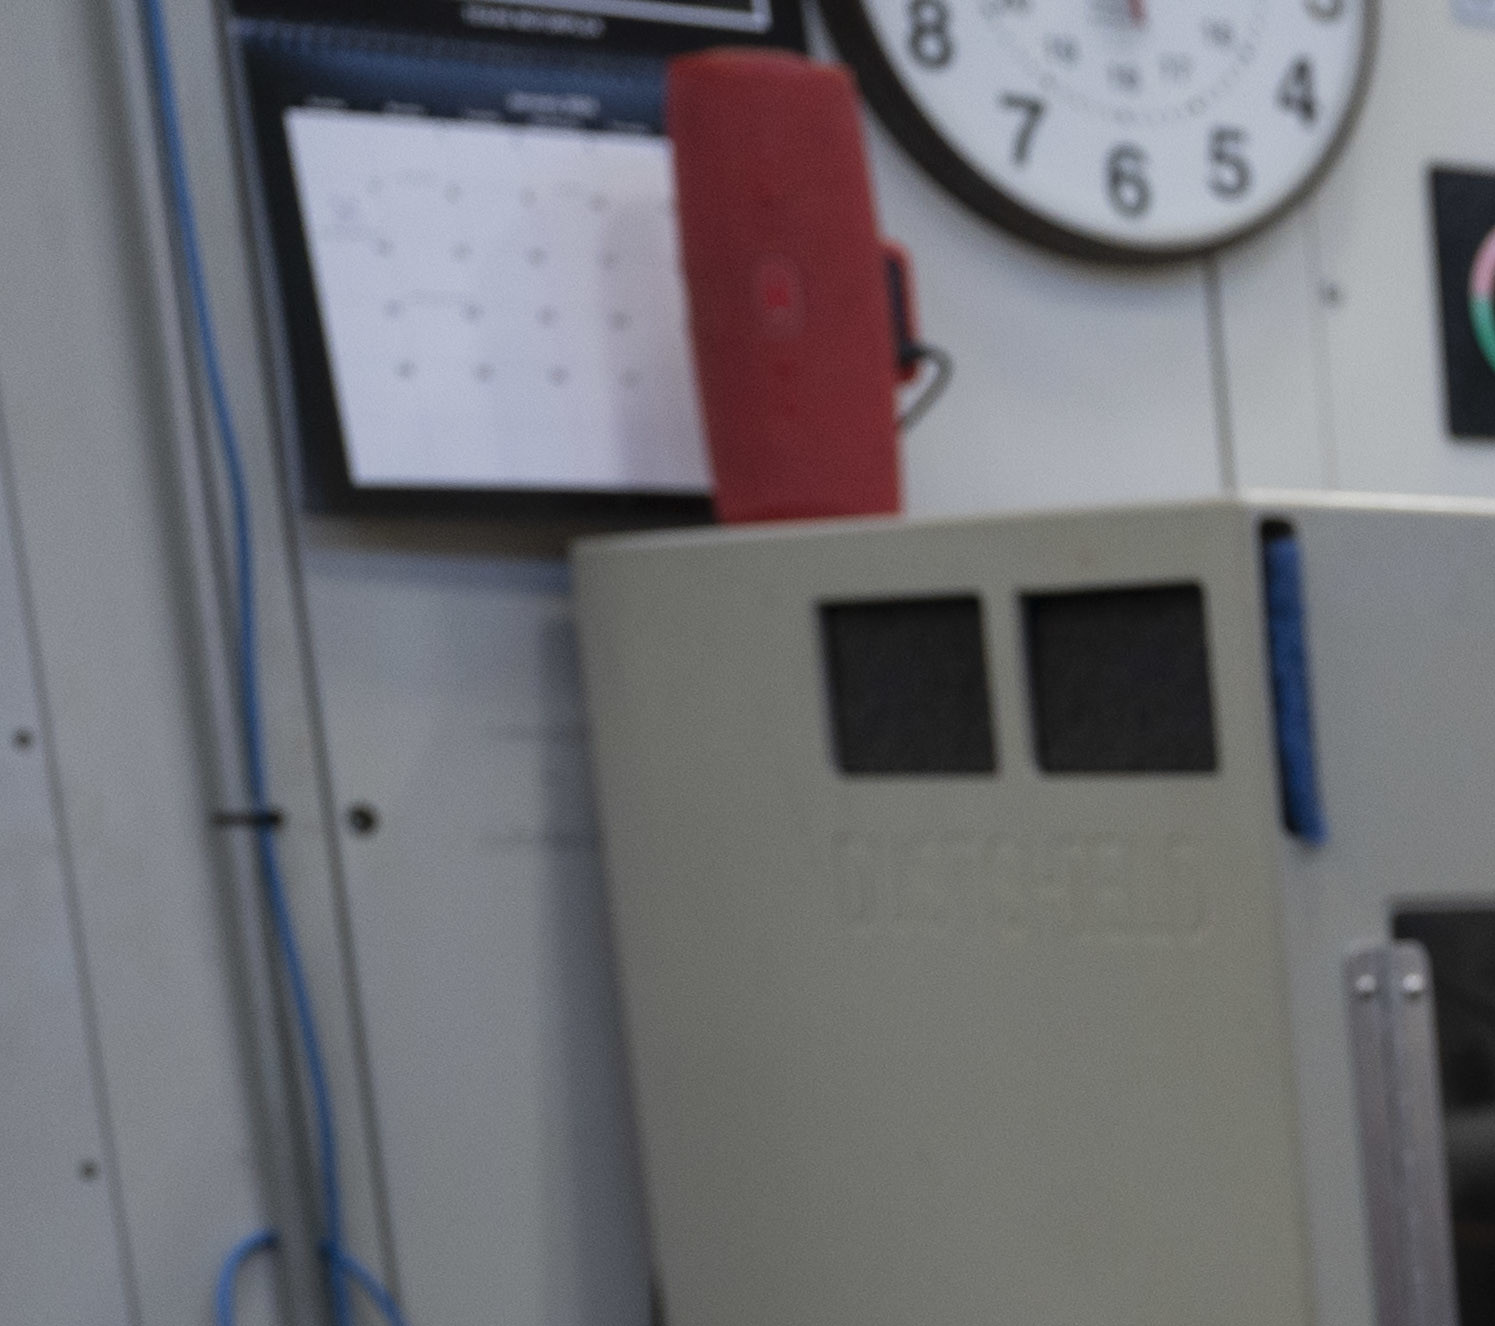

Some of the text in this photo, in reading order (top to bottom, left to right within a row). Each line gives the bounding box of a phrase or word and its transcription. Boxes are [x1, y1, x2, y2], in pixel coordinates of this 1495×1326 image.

[909, 0, 954, 68] 8
[1277, 56, 1316, 126] 4
[1000, 92, 1045, 163] 7
[1208, 127, 1253, 197] 5
[1105, 142, 1151, 216] 6
